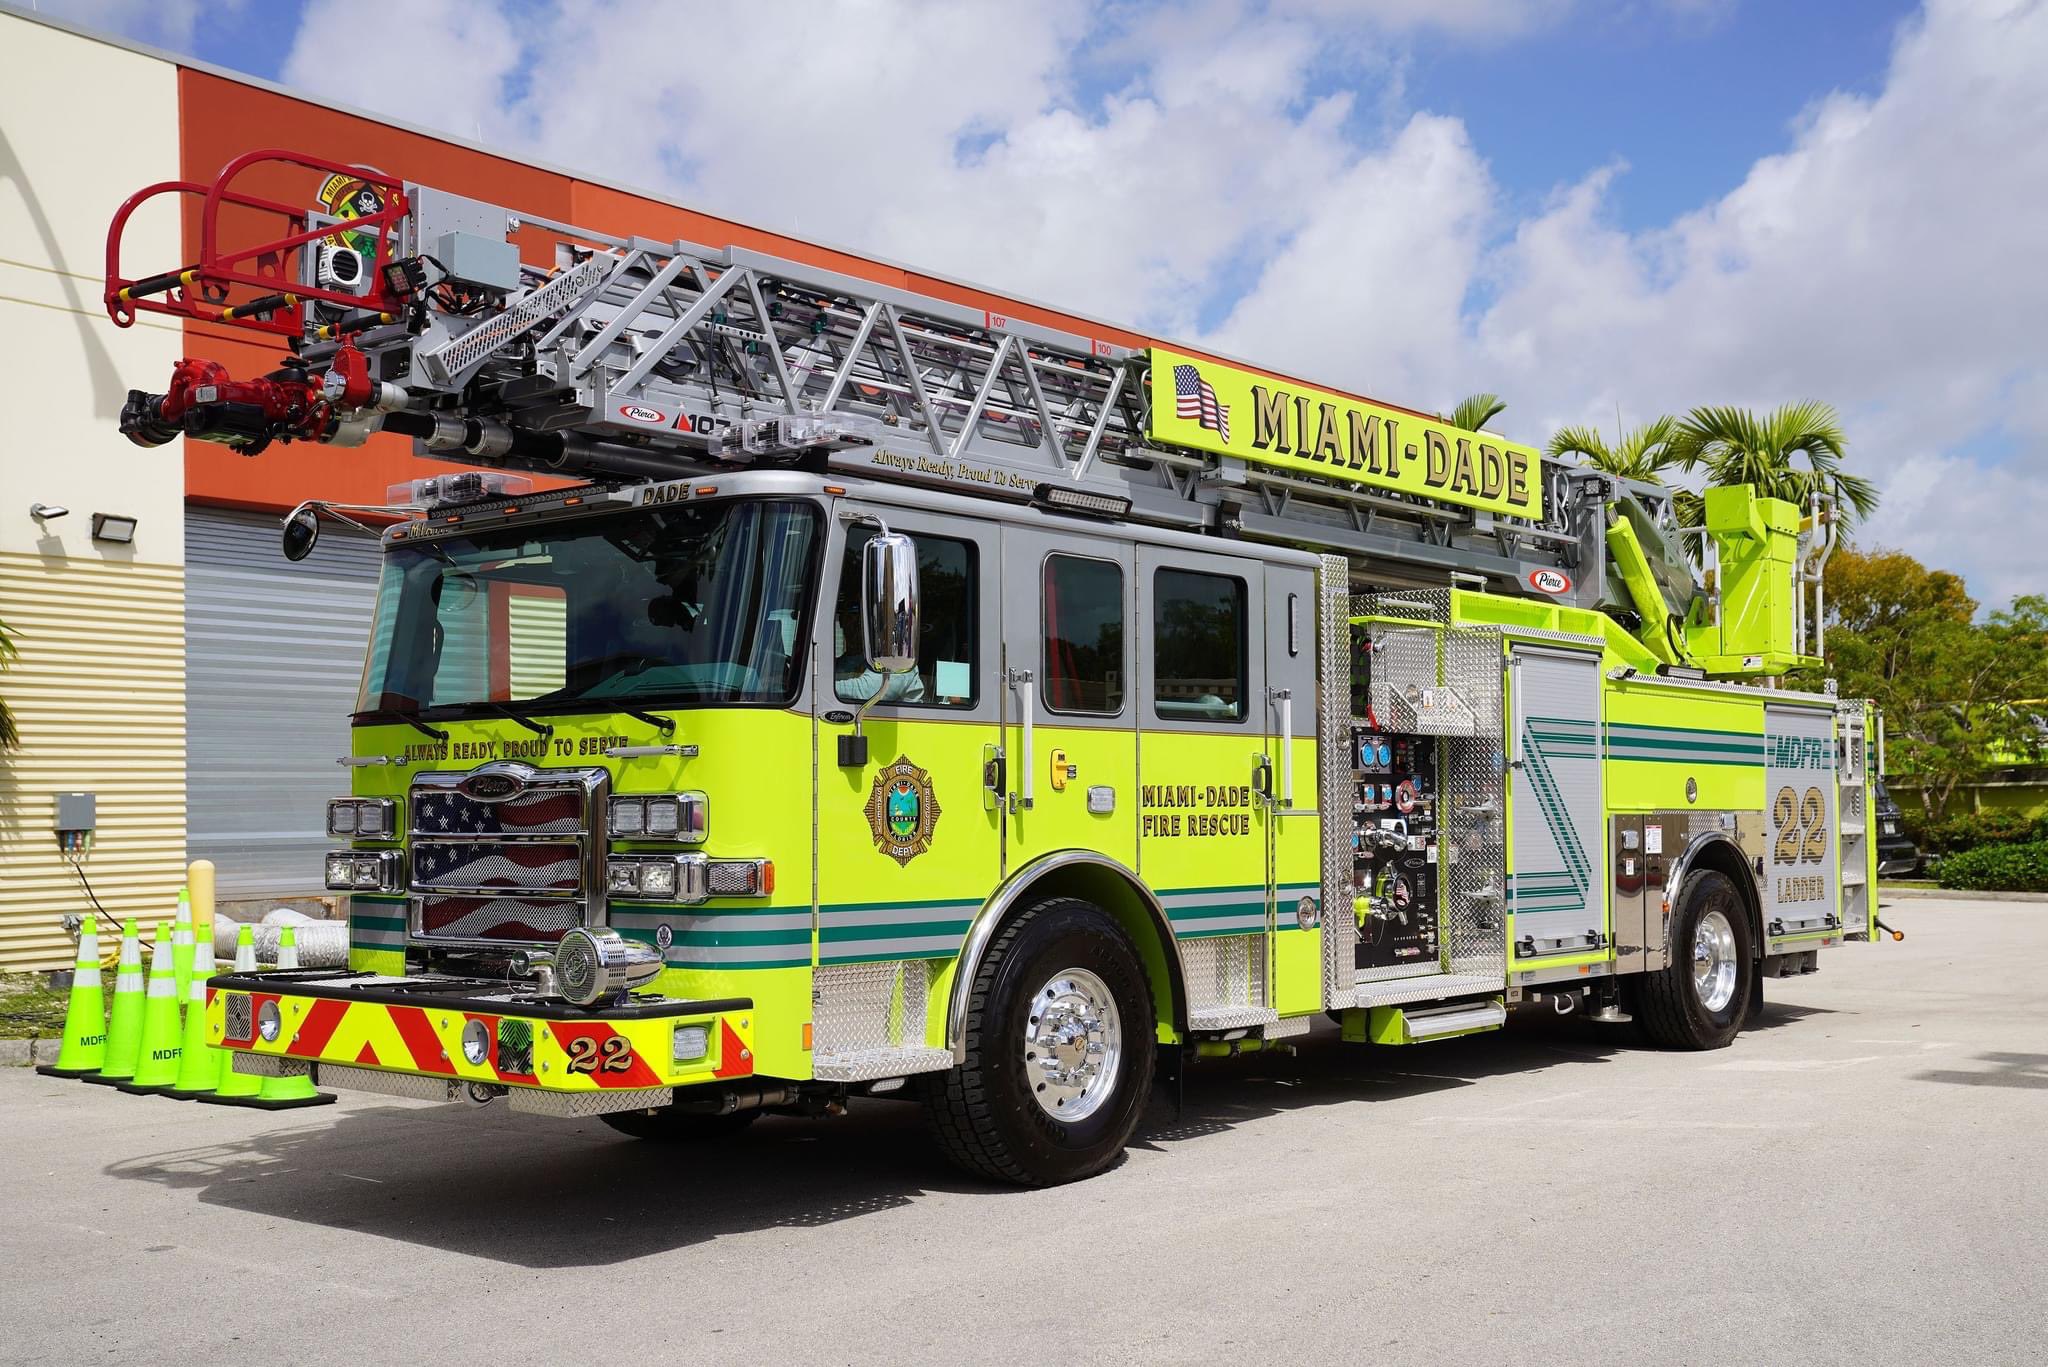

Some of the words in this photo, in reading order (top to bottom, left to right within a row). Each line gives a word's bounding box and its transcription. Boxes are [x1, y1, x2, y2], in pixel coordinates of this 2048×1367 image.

[992, 316, 1006, 328] 107
[1097, 344, 1112, 356] 100
[630, 407, 656, 420] Pierce
[1251, 385, 1530, 507] MIAMI-DADE
[871, 448, 915, 471] Always
[916, 455, 954, 480] Ready,
[957, 462, 991, 484] Proud
[994, 469, 1008, 486] To
[642, 482, 691, 506] DADE
[1539, 572, 1562, 589] Pierce
[404, 742, 449, 762] ALWAYS
[453, 740, 498, 761] READY,
[503, 738, 549, 758] PROUD
[554, 737, 574, 757] TO
[1775, 734, 1823, 769] MDFR
[895, 765, 913, 775] FIRE
[1142, 785, 1250, 808] MIAMI-DADE
[1143, 815, 1181, 837] FIRE
[1188, 813, 1250, 836] RESCUE
[1773, 786, 1827, 867] 22
[1776, 876, 1825, 903] LADDER
[567, 1035, 633, 1075] 22
